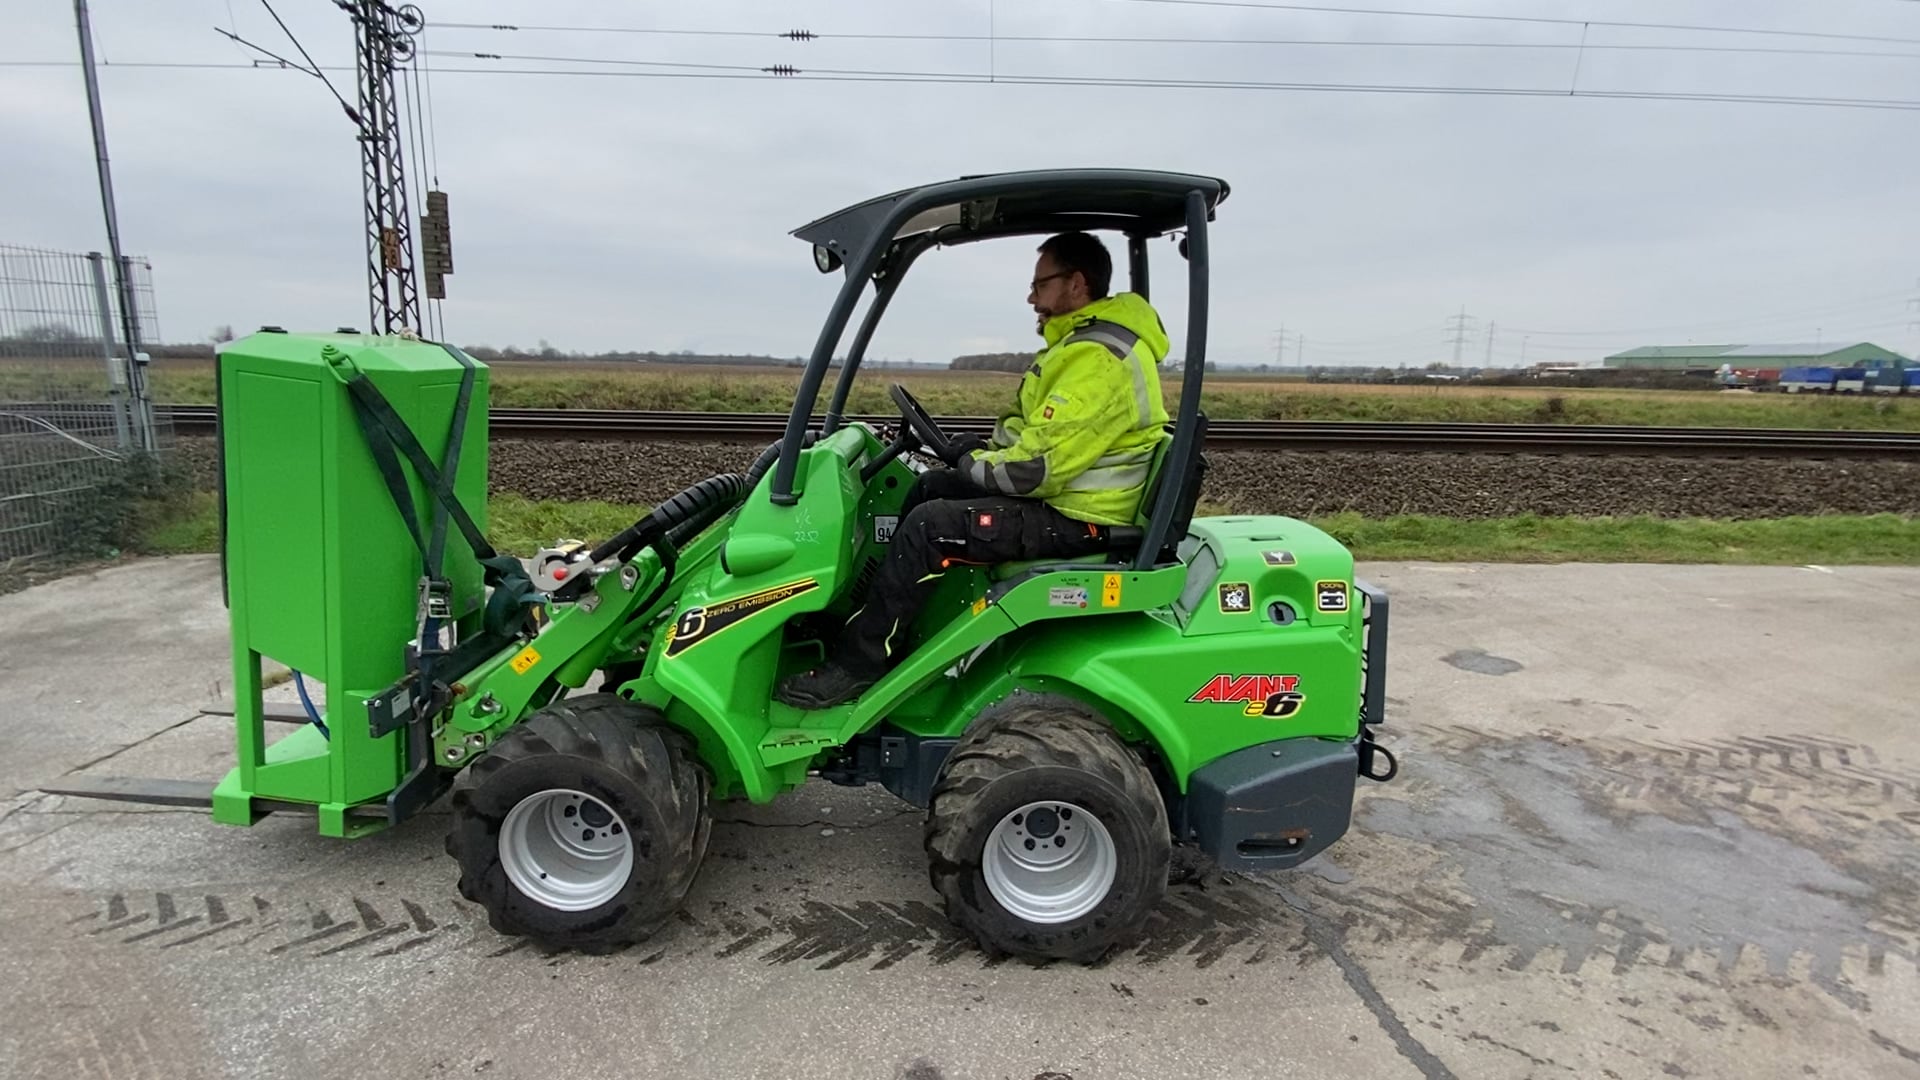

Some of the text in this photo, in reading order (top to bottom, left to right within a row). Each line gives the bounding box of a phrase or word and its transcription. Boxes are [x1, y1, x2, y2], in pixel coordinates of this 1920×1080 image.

[706, 589, 793, 618] ZERO EMISSION
[1184, 674, 1300, 703] AVANT
[1243, 691, 1306, 719] e6
